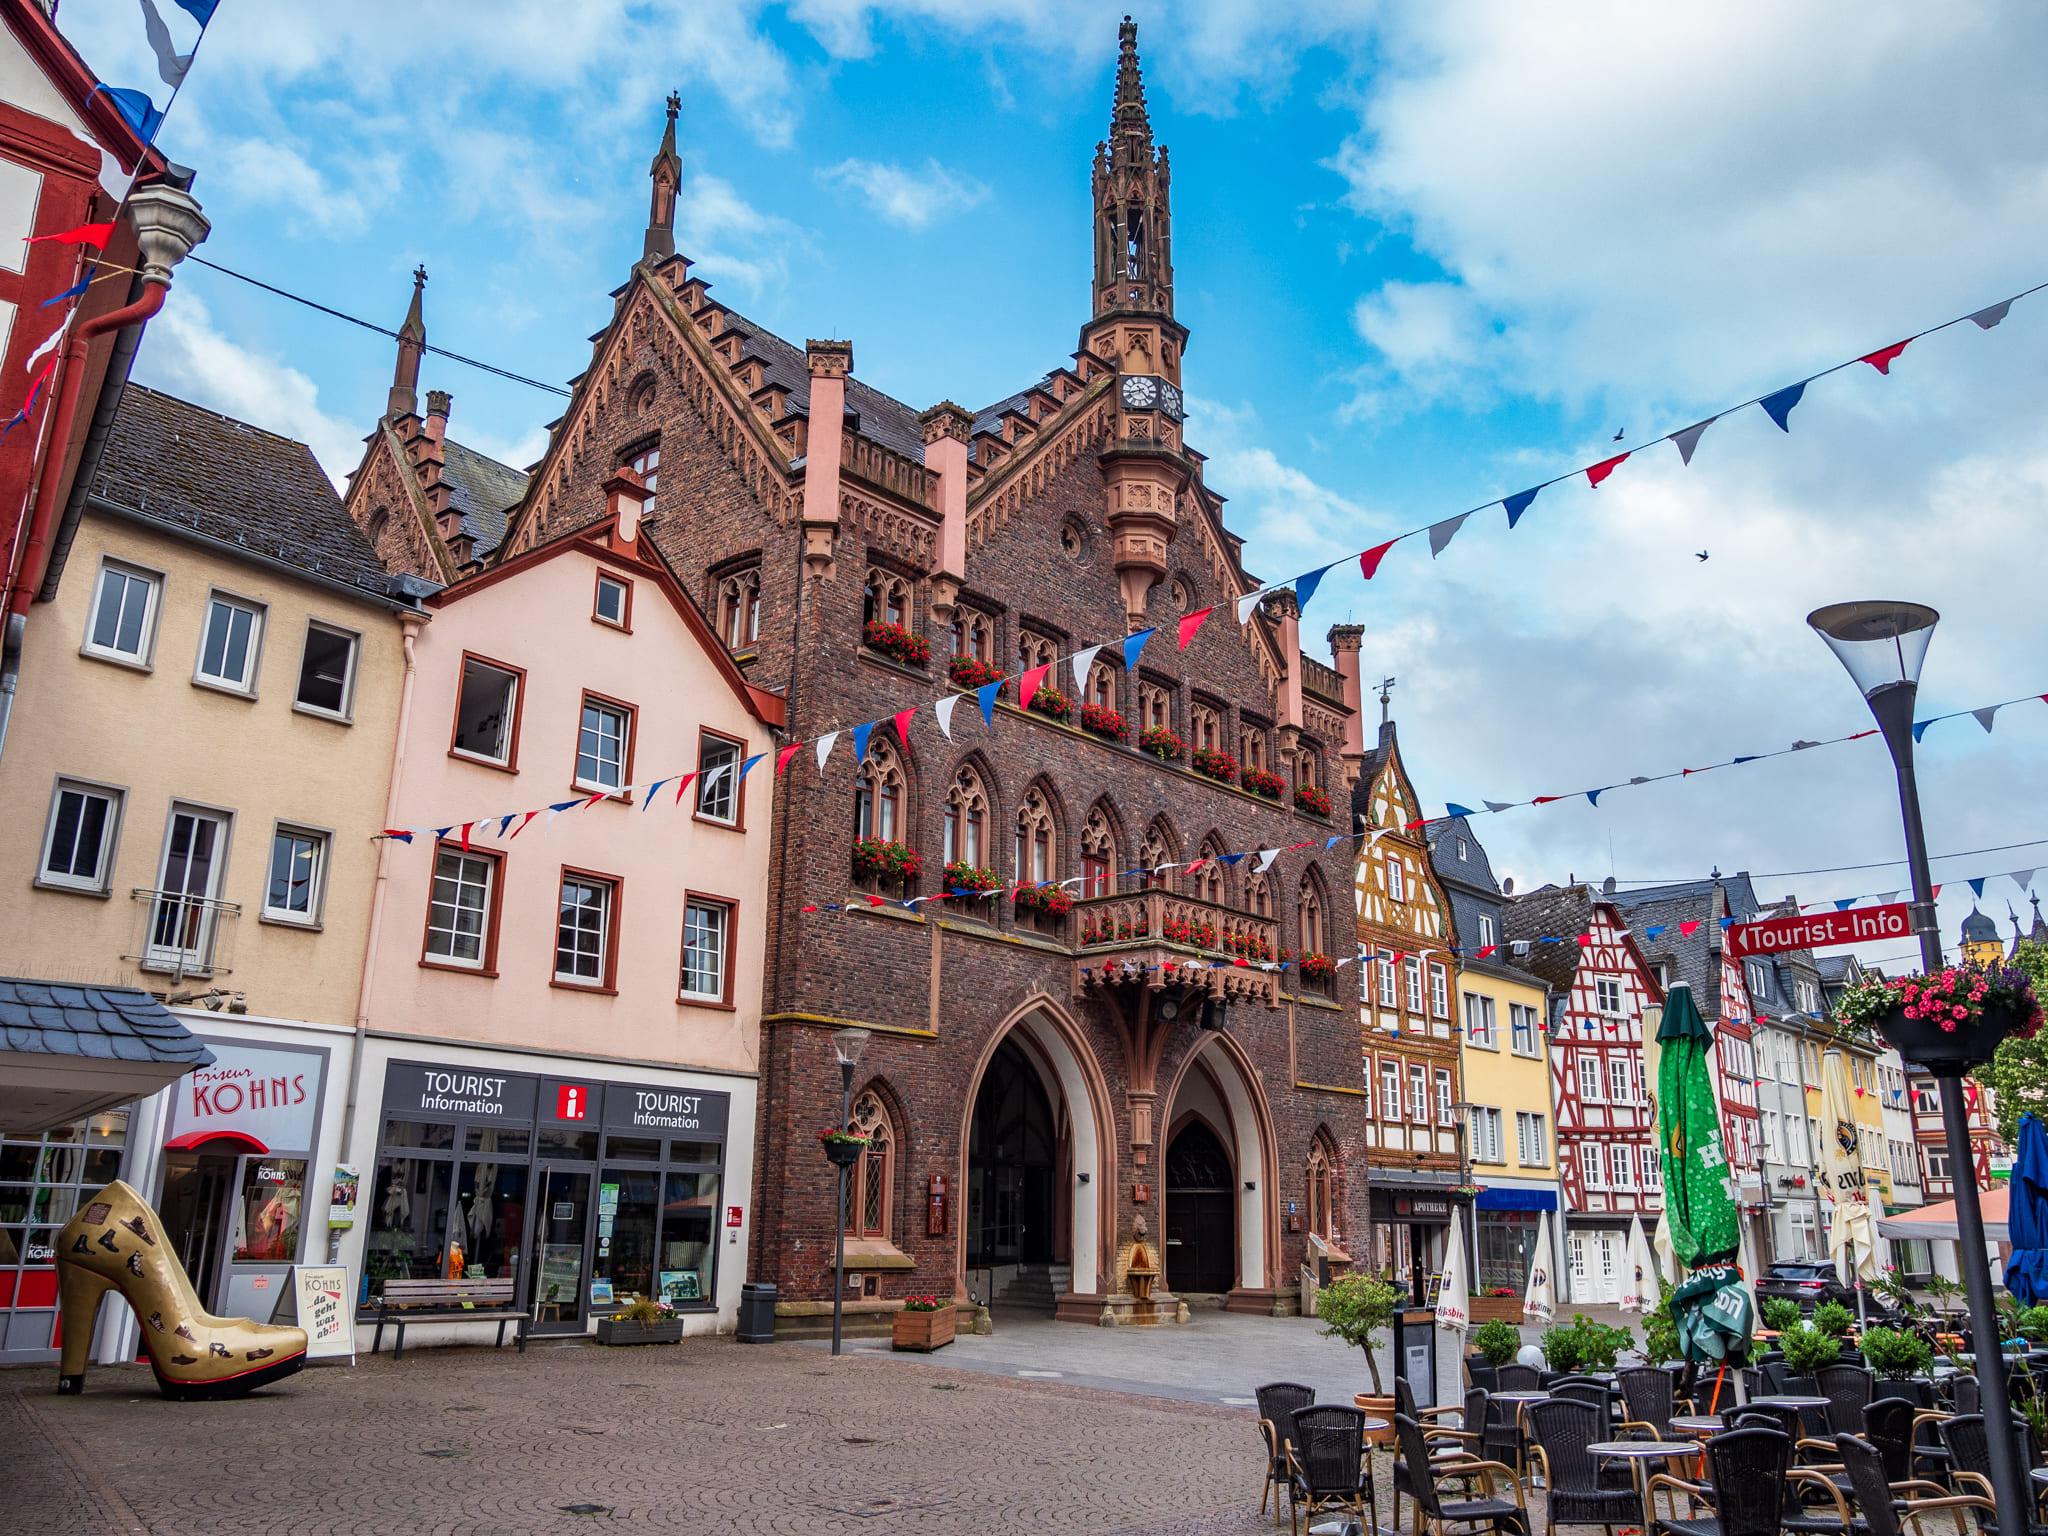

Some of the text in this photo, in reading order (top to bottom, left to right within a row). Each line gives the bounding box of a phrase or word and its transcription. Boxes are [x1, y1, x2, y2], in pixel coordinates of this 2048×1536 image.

[1749, 911, 1903, 949] Tourist-Info
[192, 1067, 253, 1086] Friseur
[425, 1071, 506, 1097] TOURIST
[193, 1074, 306, 1117] KOHNS
[421, 1094, 503, 1114] Information
[635, 1092, 701, 1114] TOURIST
[633, 1111, 699, 1129] Information
[257, 1171, 286, 1180] KOHNS
[1413, 1201, 1447, 1213] APOTHEKE
[305, 1279, 341, 1291] KOHNS
[314, 1301, 337, 1319] geht
[316, 1314, 335, 1328] was
[317, 1321, 339, 1339] ab!!!
